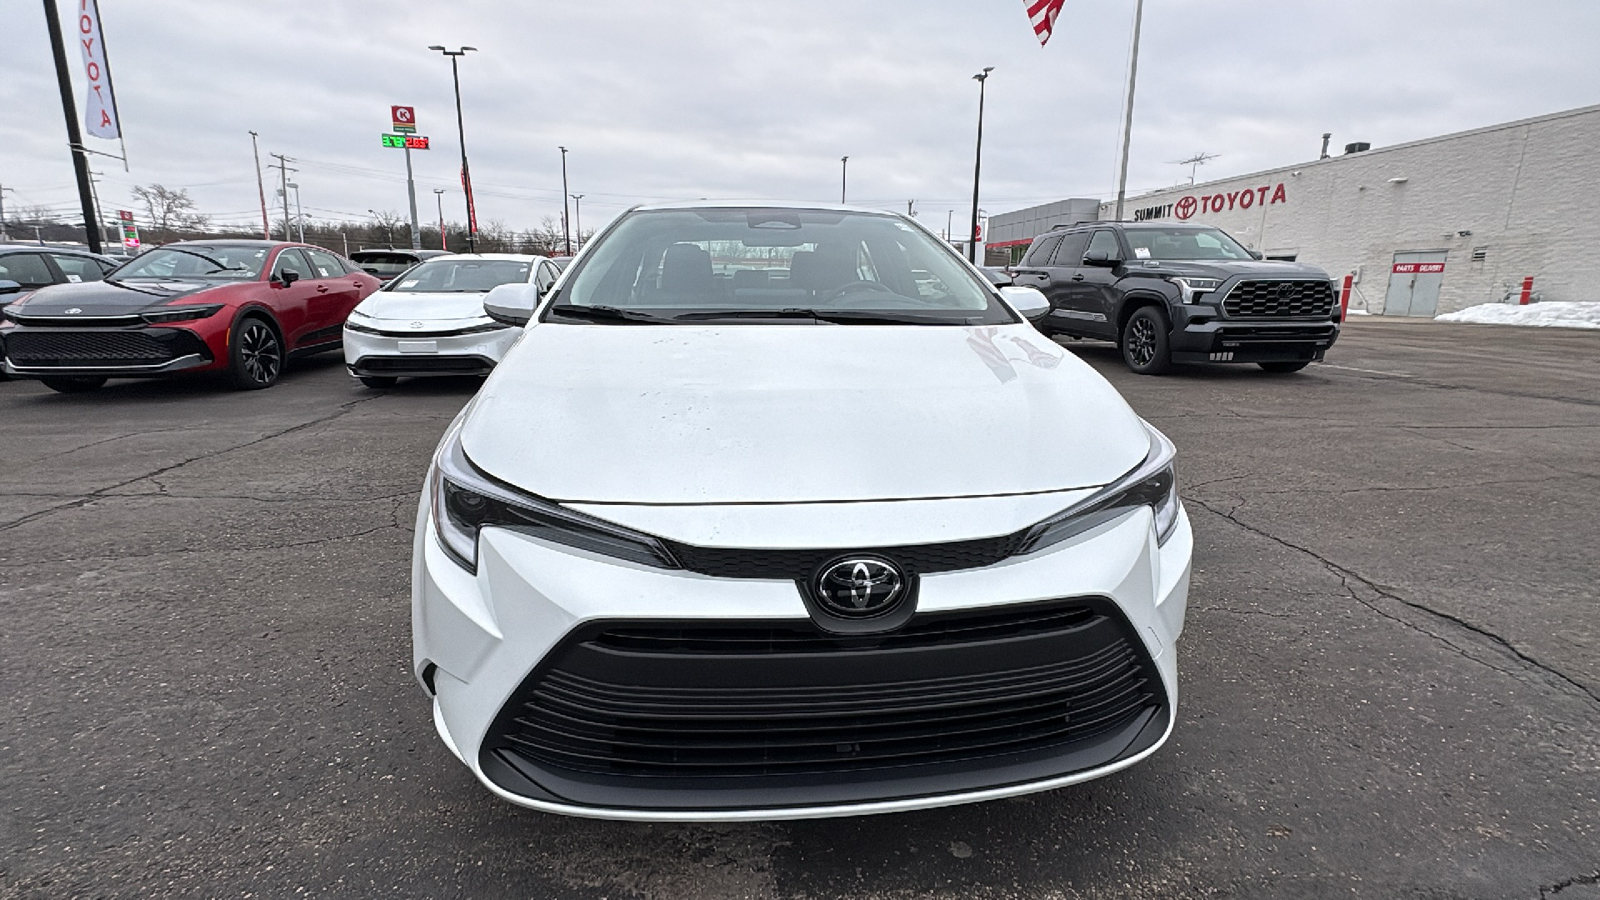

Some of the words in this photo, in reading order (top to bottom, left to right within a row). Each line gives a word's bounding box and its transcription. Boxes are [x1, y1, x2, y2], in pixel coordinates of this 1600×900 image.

[398, 109, 411, 121] K
[1134, 204, 1173, 221] SUMMIT
[1201, 183, 1286, 213] TOYOTA
[1396, 264, 1415, 272] PARTS
